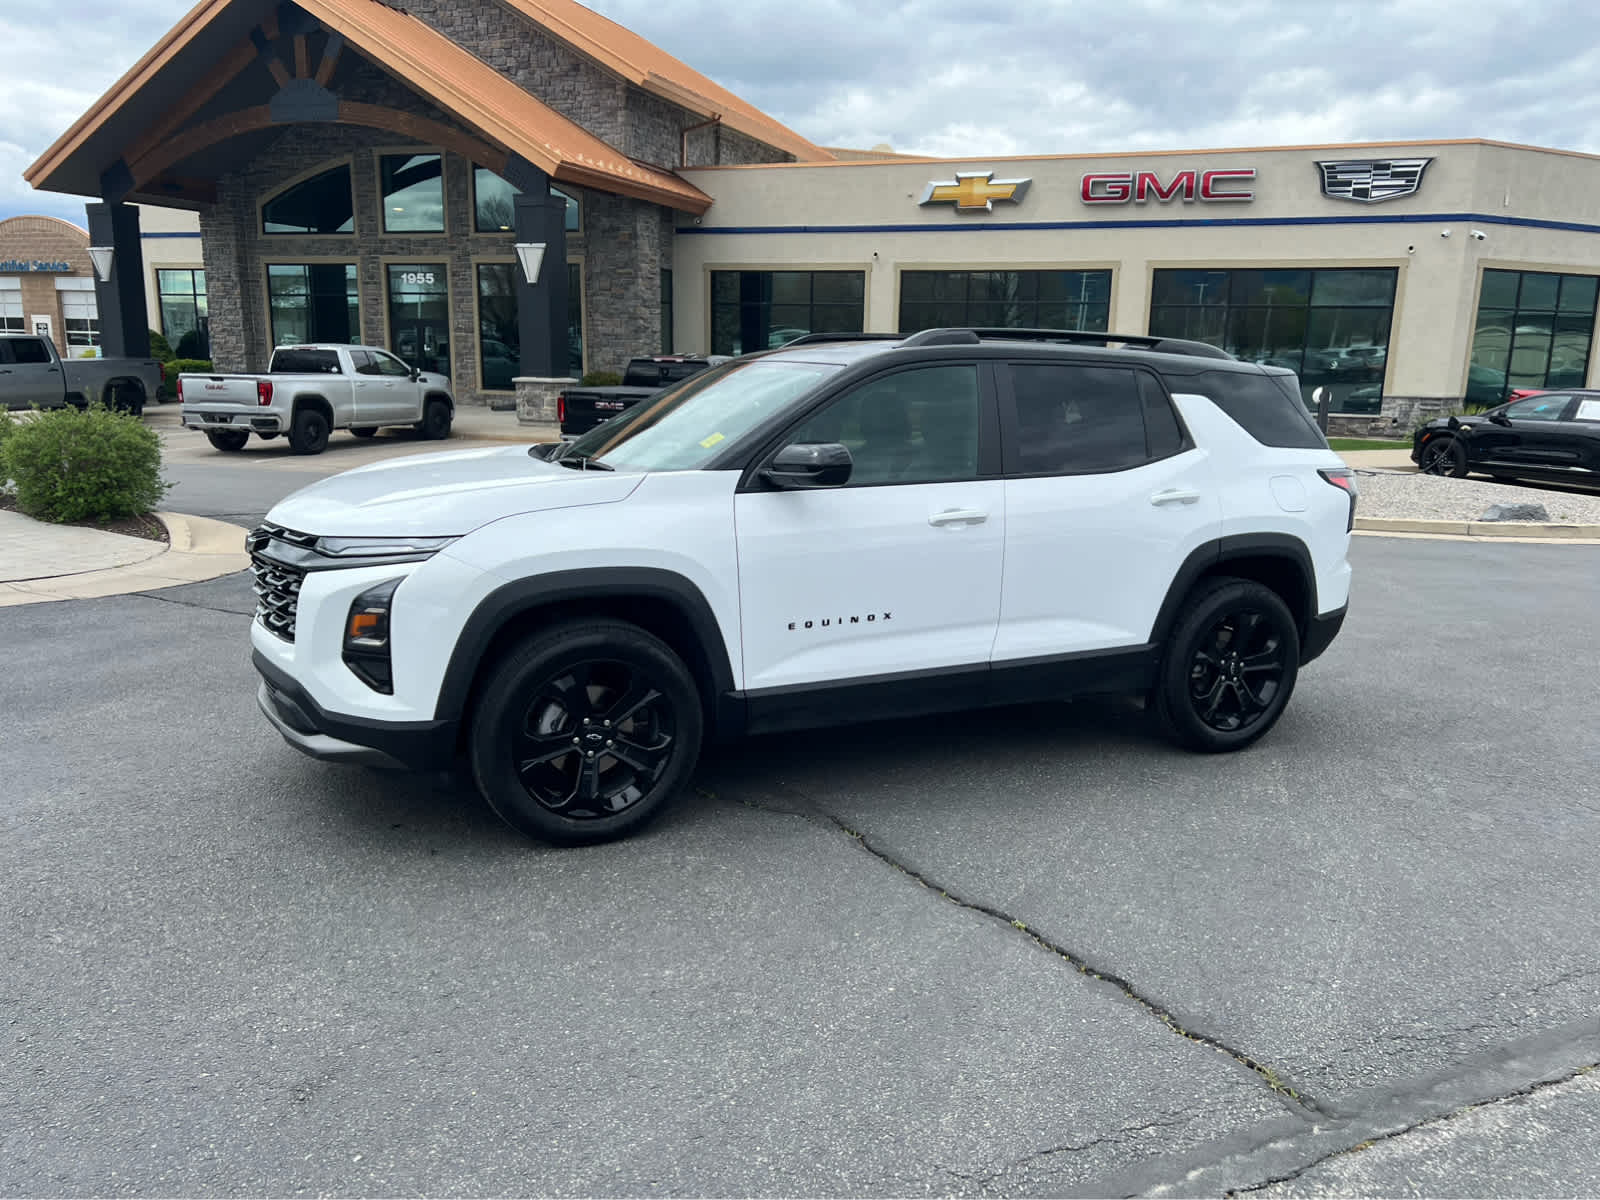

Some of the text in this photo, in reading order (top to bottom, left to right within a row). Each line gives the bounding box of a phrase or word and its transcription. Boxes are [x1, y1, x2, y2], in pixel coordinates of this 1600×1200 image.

[1080, 168, 1257, 204] GMC
[32, 260, 70, 272] Service
[401, 272, 434, 284] 1955
[594, 401, 624, 409] GMC
[787, 612, 892, 630] EQUINOX
